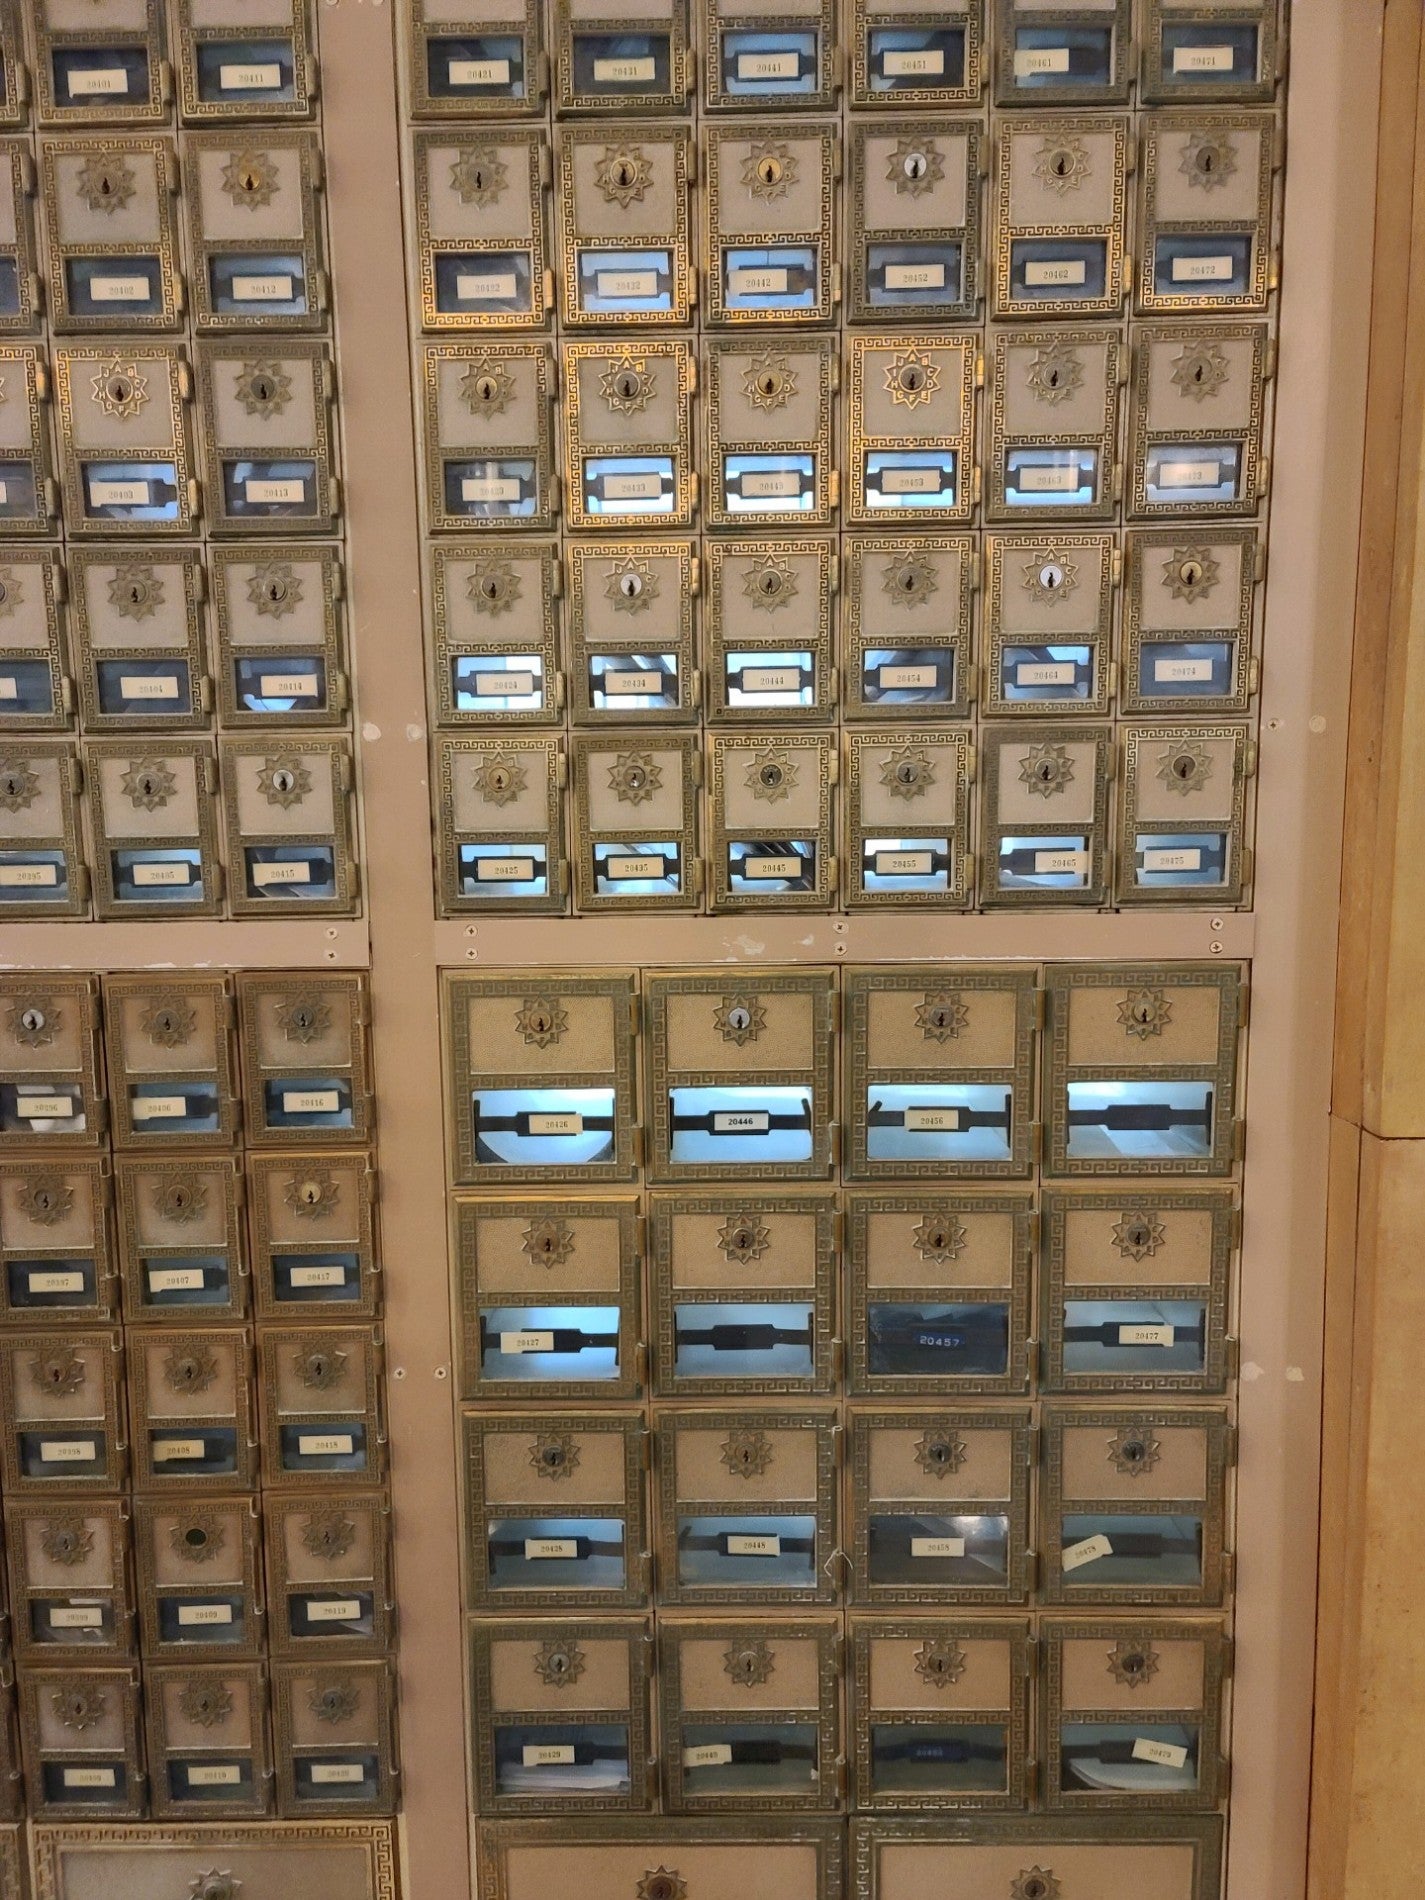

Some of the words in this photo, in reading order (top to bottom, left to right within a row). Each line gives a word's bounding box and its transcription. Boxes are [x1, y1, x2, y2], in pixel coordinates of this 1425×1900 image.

[756, 64, 781, 72] 20441
[902, 61, 926, 69] 20451
[1043, 270, 1068, 278] 20462
[1190, 266, 1215, 274] 20472
[903, 274, 928, 282] 20452
[746, 279, 771, 287] 20442
[621, 484, 645, 492] 20433
[264, 489, 288, 497] 20413
[494, 681, 517, 689] 20424
[760, 677, 784, 685] 20444
[762, 864, 786, 872] 20445
[893, 860, 916, 868] 20455
[920, 1336, 959, 1346] 20457
